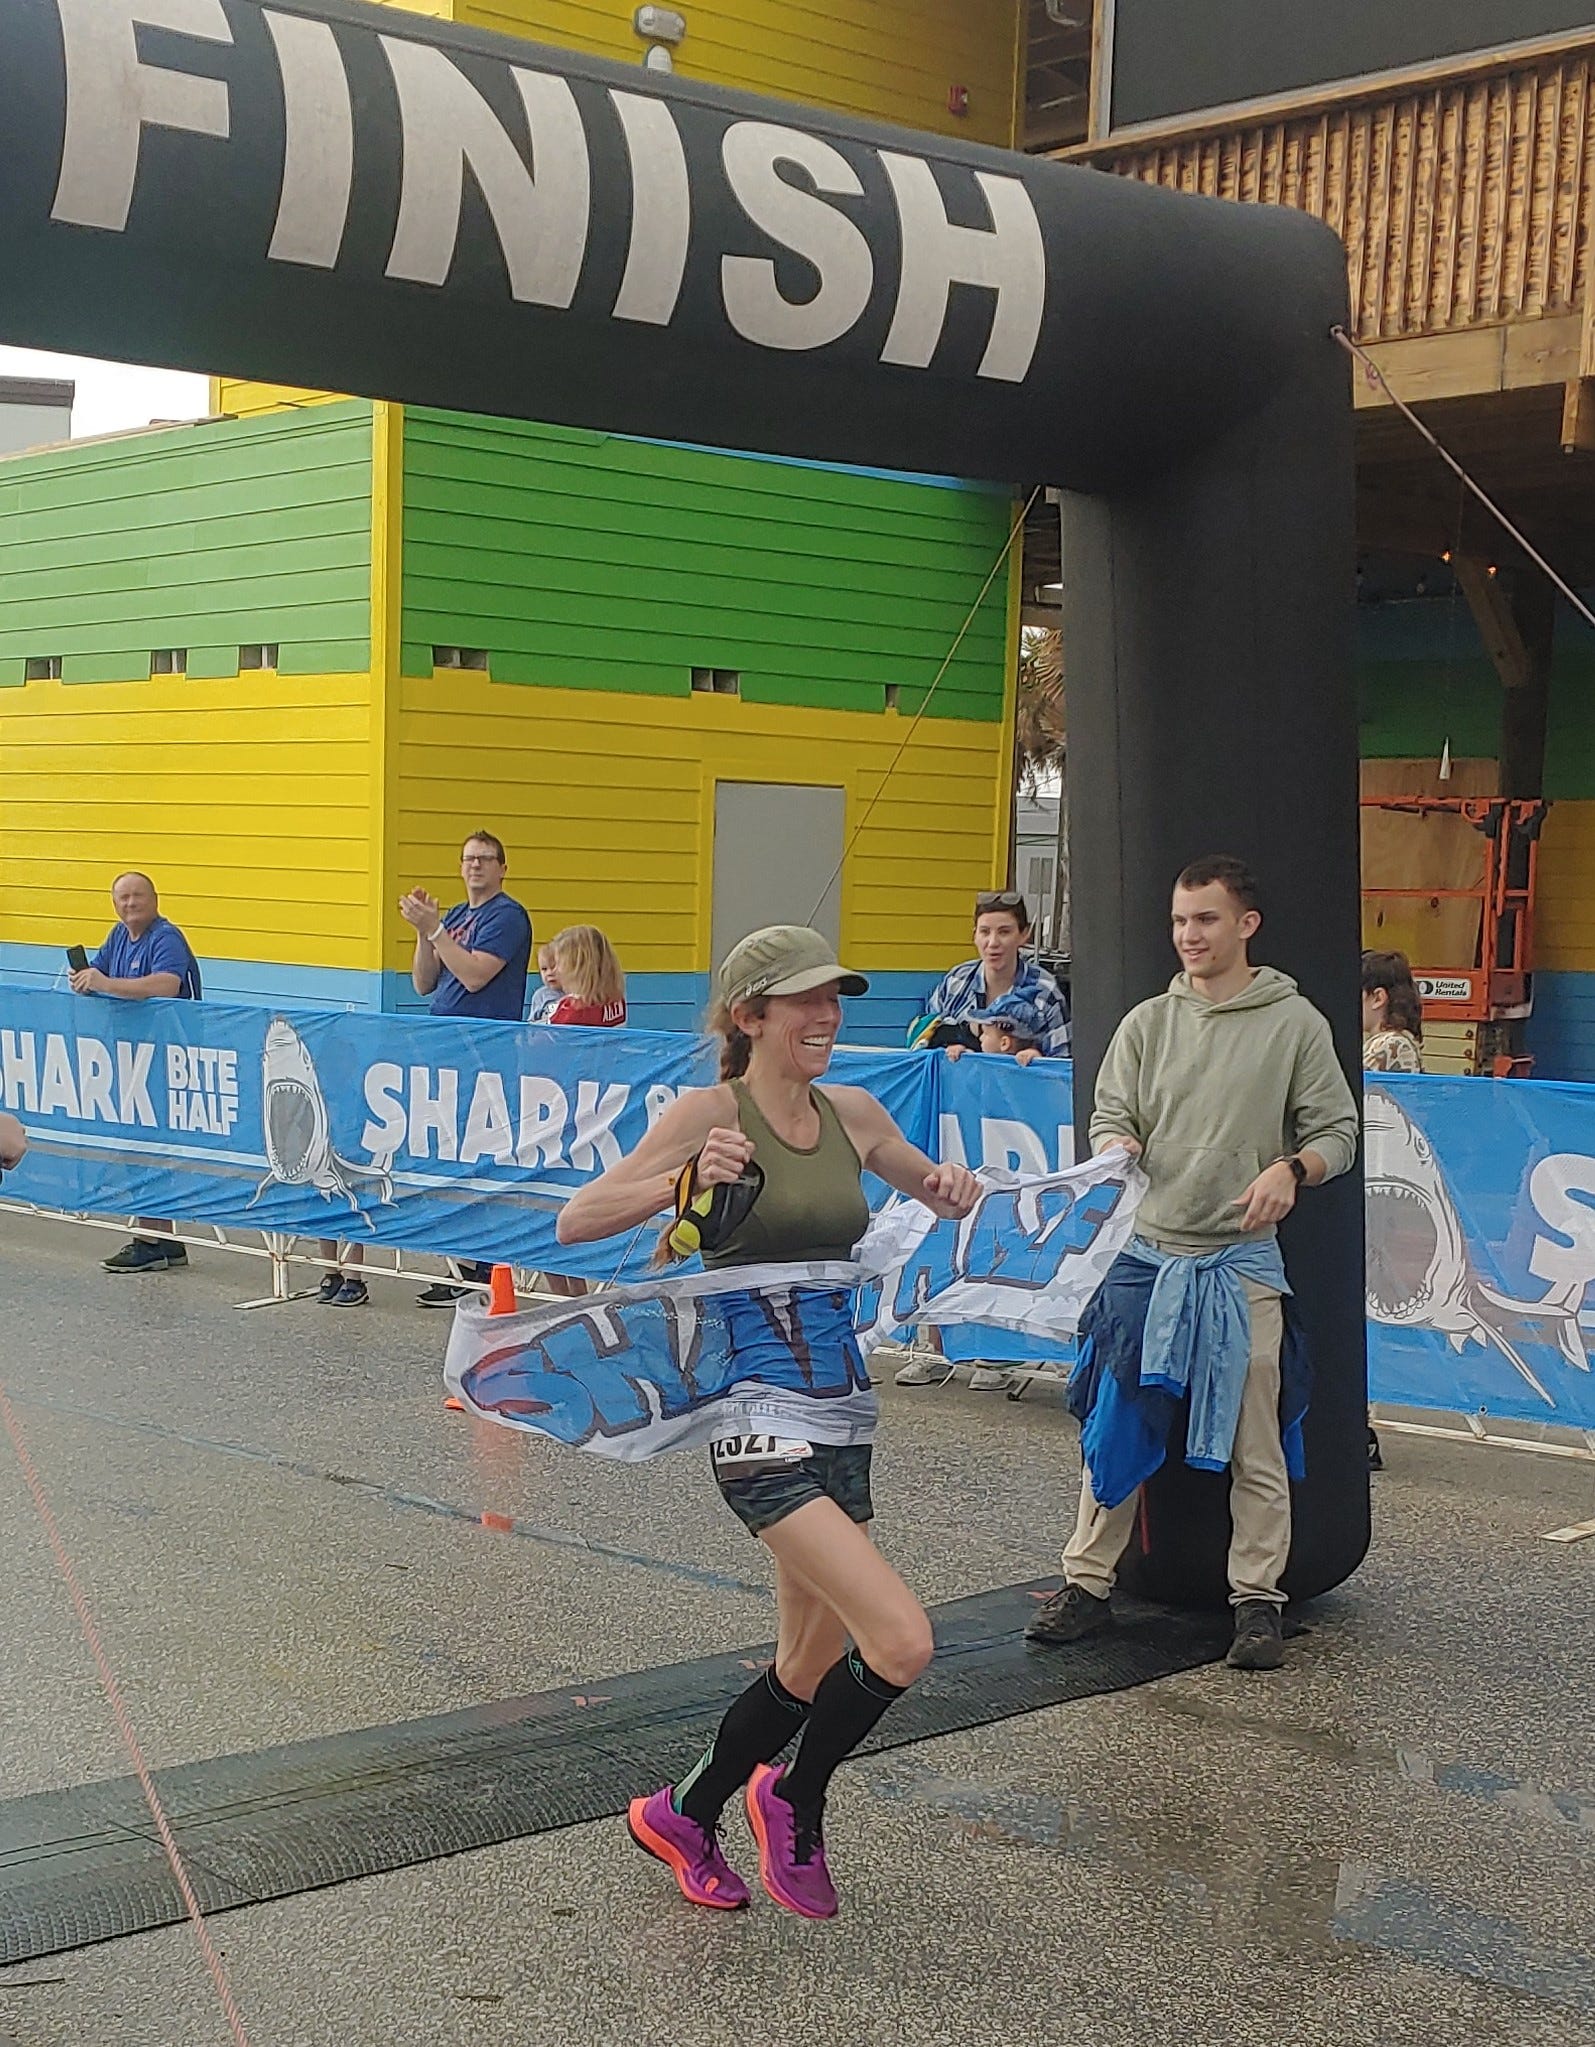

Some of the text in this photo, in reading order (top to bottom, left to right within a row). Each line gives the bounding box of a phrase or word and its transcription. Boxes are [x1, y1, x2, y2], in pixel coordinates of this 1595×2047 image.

[50, 0, 1046, 384] FINISH
[1434, 989, 1467, 997] Rentals
[1435, 981, 1467, 989] United
[0, 1028, 158, 1128] HARK
[166, 1044, 239, 1095] BITE
[167, 1089, 239, 1137] HALF
[360, 1062, 631, 1174] SHARK
